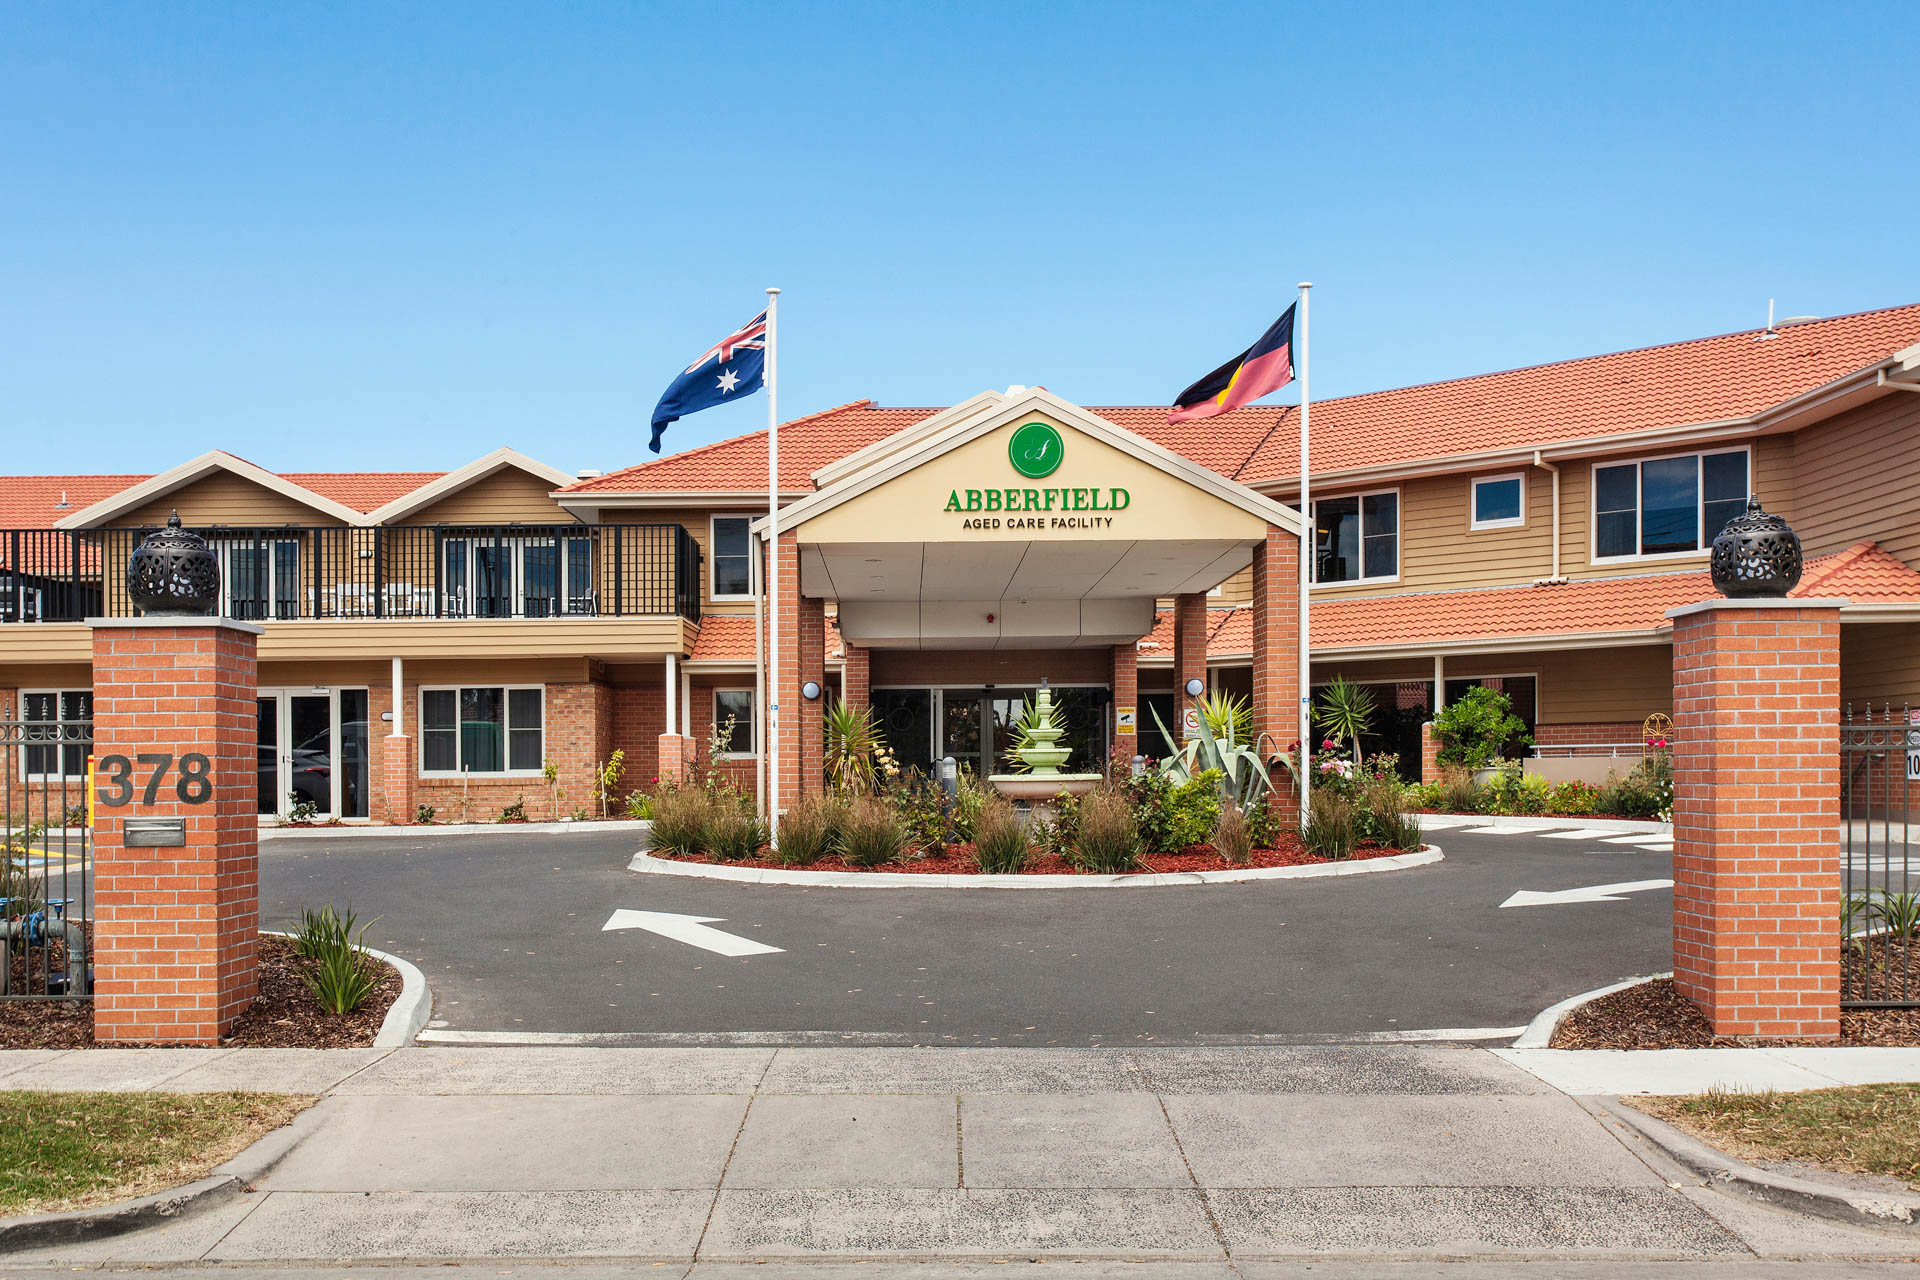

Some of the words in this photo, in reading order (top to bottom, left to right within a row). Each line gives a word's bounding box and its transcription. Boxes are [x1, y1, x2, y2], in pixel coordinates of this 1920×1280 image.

[943, 487, 1131, 512] ABBERFIELD
[963, 518, 1001, 529] AGED
[1007, 518, 1045, 529] CARE
[1051, 517, 1113, 529] FACILITY
[1908, 754, 1920, 775] 10
[98, 752, 212, 807] 378
